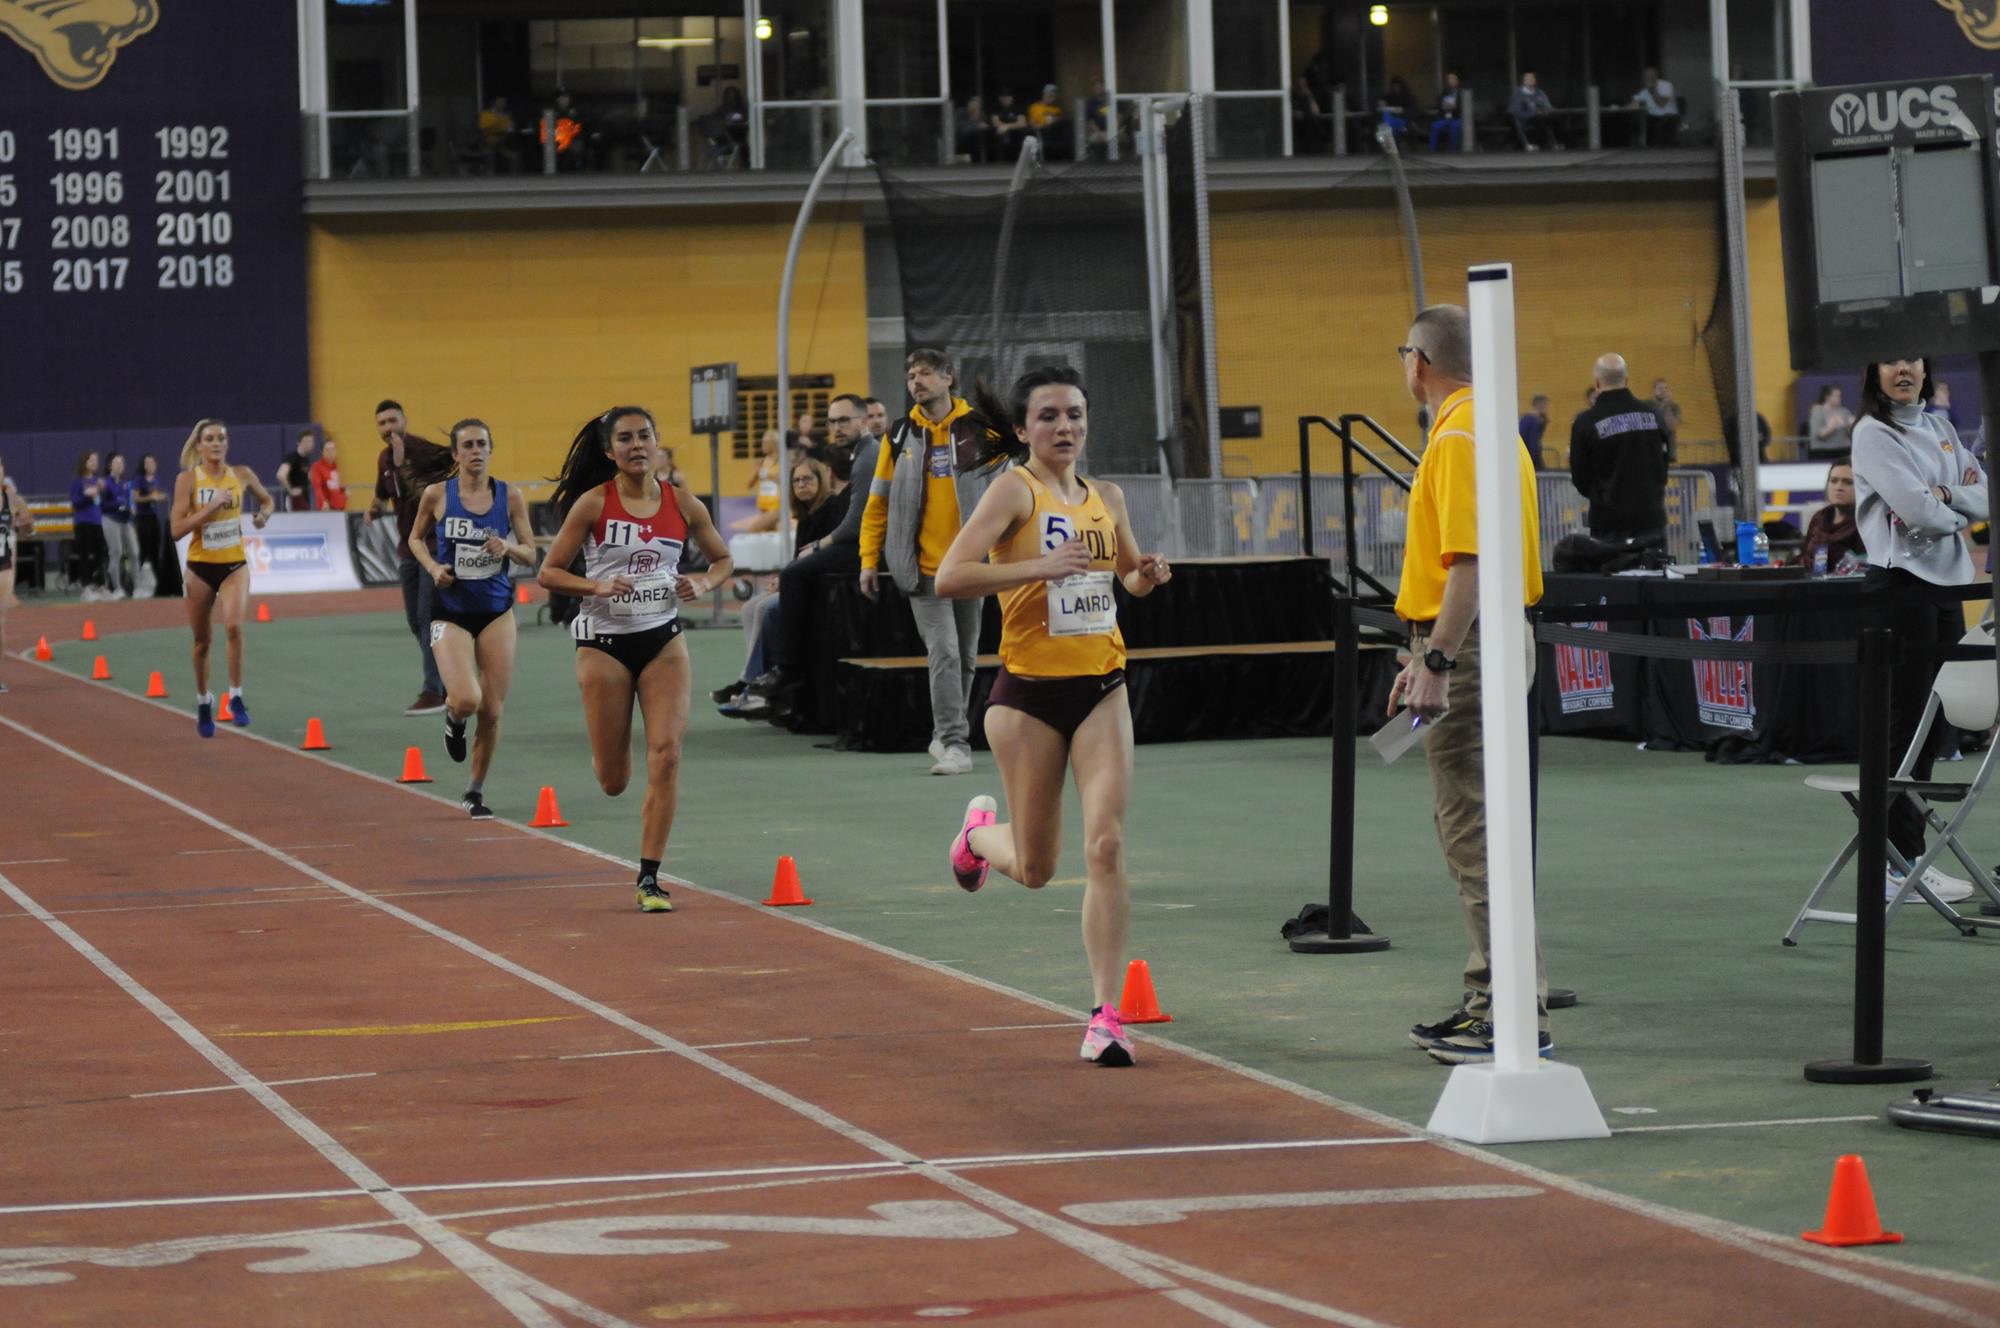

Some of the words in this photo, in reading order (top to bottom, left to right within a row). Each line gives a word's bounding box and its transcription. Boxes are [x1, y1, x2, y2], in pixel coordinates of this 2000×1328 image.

[1866, 85, 1957, 132] UCS
[49, 128, 119, 160] 1991
[155, 126, 229, 158] 1992
[50, 172, 123, 205] 1996
[155, 170, 231, 203] 2001
[51, 215, 130, 248] 2008
[157, 212, 232, 245] 2010
[52, 258, 129, 291] 2017
[158, 254, 234, 288] 2018
[200, 489, 214, 502] 17
[447, 520, 468, 537] 15
[609, 522, 632, 546] 11
[1046, 516, 1069, 550] 5
[612, 588, 669, 604] JUAREZ
[1061, 595, 1110, 615] LAIRD
